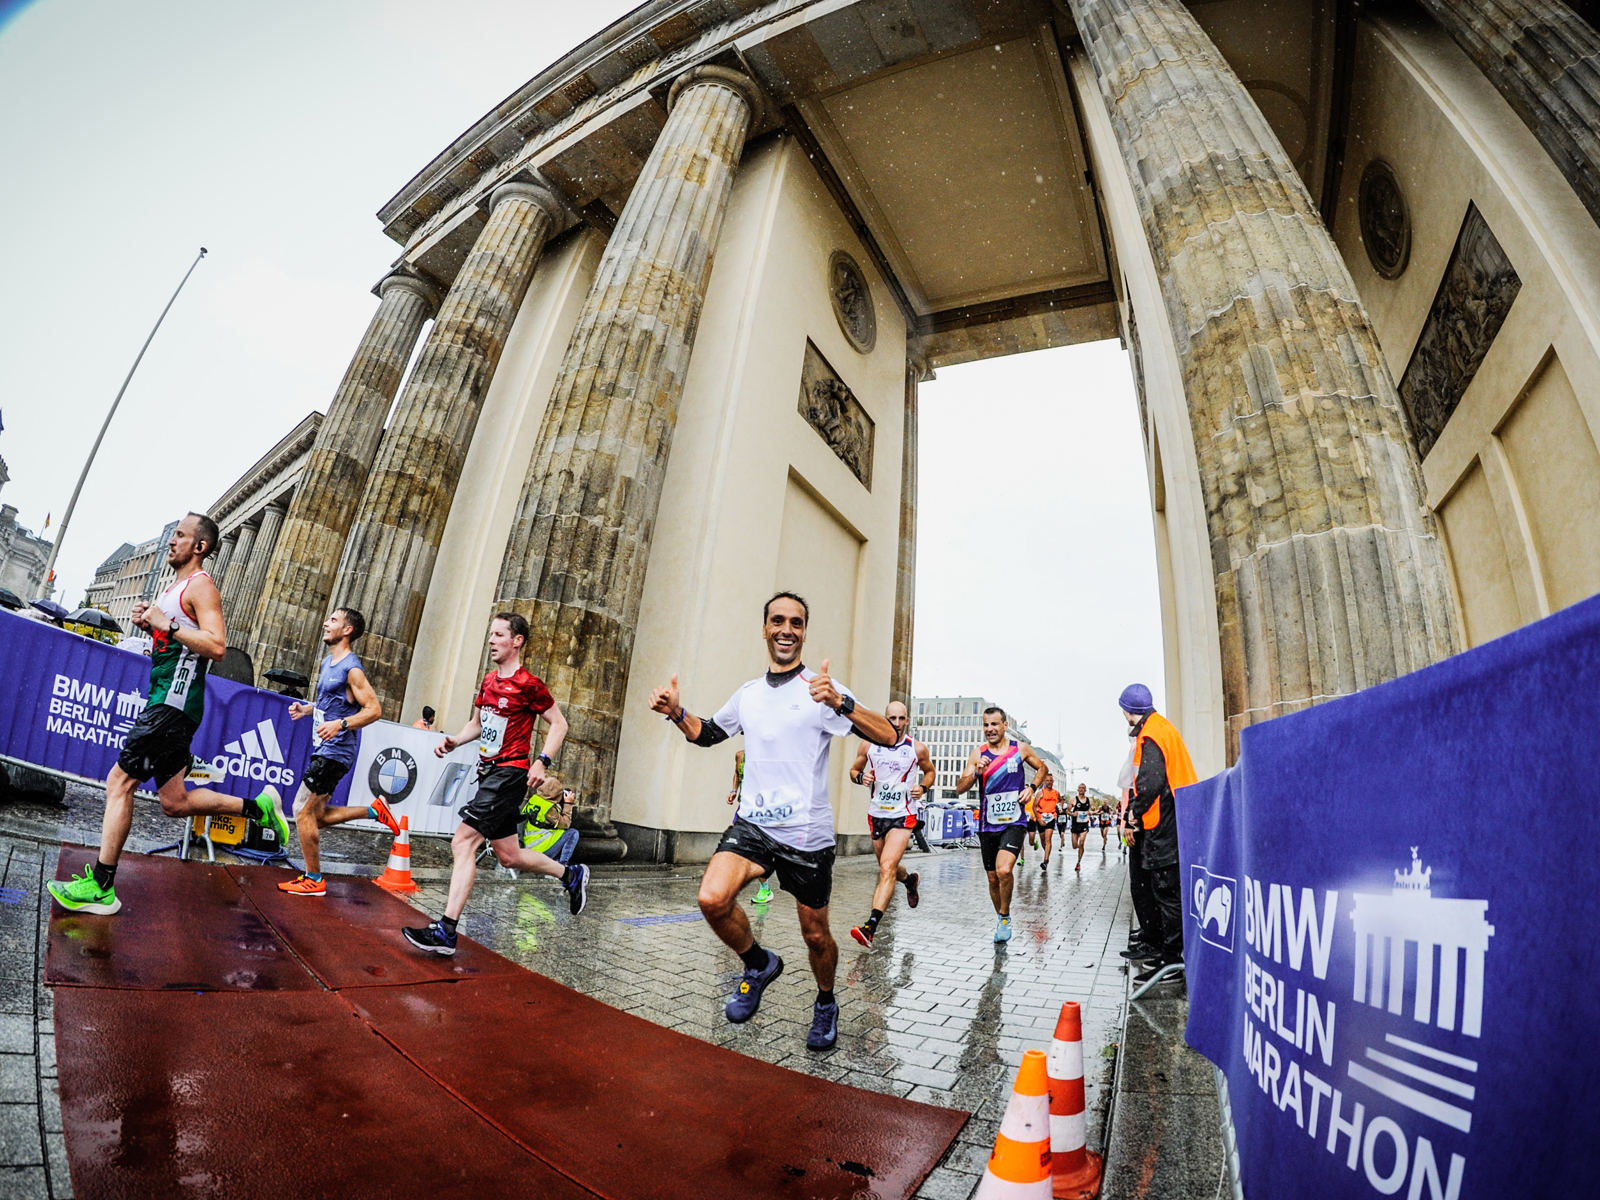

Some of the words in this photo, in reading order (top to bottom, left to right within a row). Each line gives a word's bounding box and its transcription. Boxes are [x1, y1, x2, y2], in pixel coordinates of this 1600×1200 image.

[174, 650, 194, 695] LES
[52, 673, 115, 710] BMW
[49, 697, 111, 728] BERLIN
[46, 715, 128, 750] MARATHO
[481, 726, 497, 742] 689
[211, 754, 295, 786] adidas
[376, 749, 416, 770] BMW
[991, 801, 1016, 812] 13225
[206, 820, 236, 835] ming
[1244, 874, 1339, 981] BMW
[1245, 953, 1336, 1067] BERLIN
[1244, 1011, 1466, 1200] MARATHON
